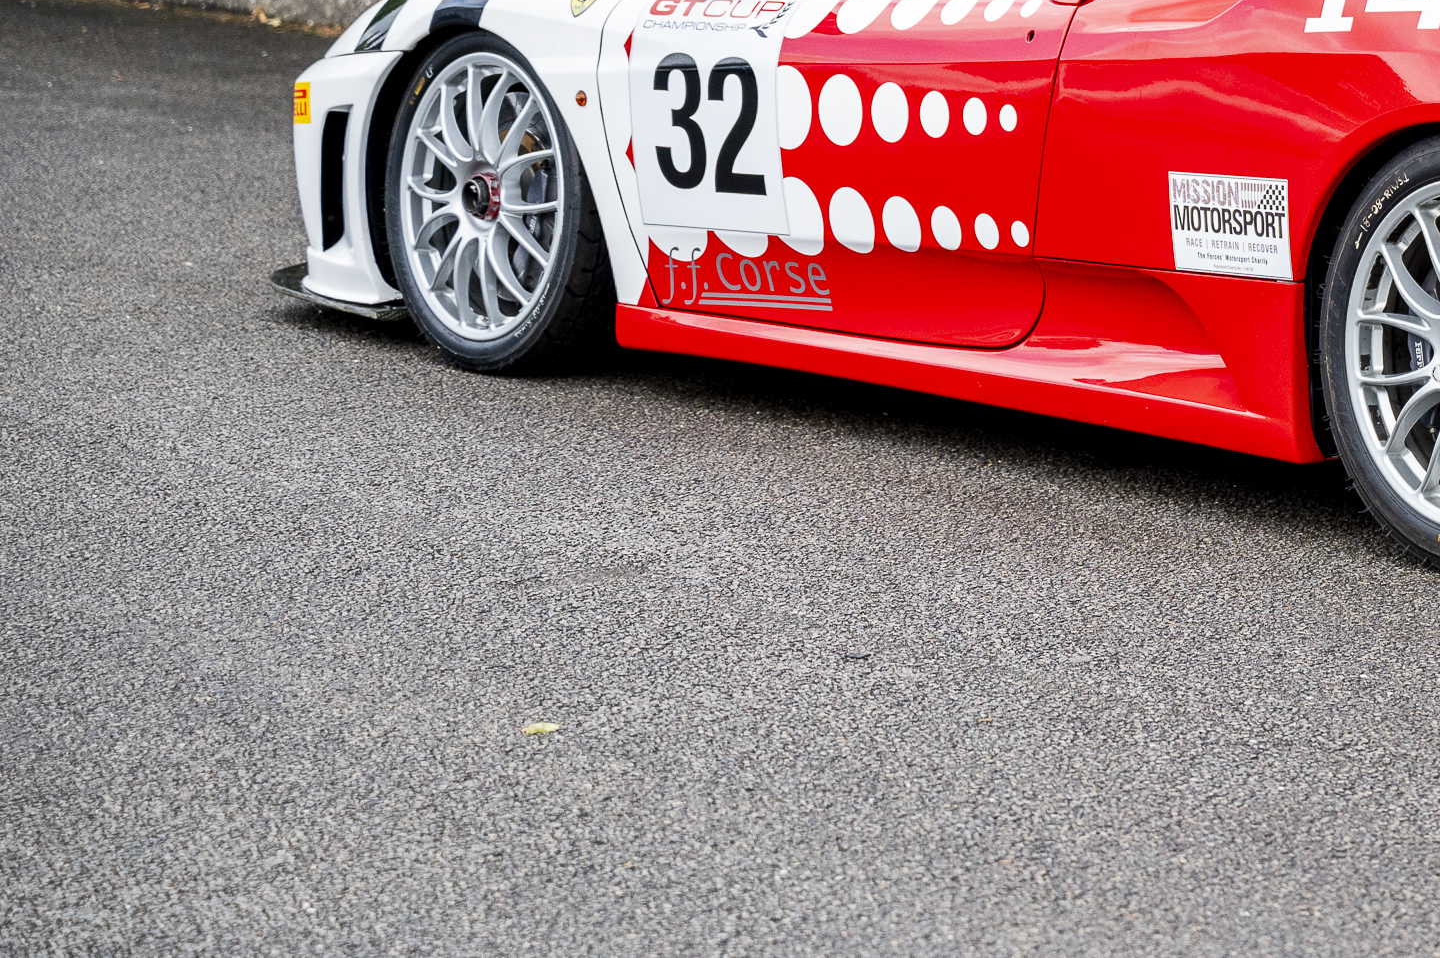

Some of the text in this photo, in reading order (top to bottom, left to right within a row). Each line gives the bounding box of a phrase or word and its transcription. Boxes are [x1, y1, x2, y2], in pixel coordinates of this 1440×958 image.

[643, 19, 747, 32] CHAMPIONSHIP
[653, 52, 767, 196] 32
[1172, 178, 1240, 208] MISSION
[1173, 204, 1286, 239] MOTORSPORT
[1185, 237, 1278, 254] RACE RETRAIN RECOVER
[1197, 251, 1206, 259] The
[1224, 254, 1251, 264] Motorsport
[1251, 256, 1268, 266] Charity
[715, 252, 831, 296] Corse
